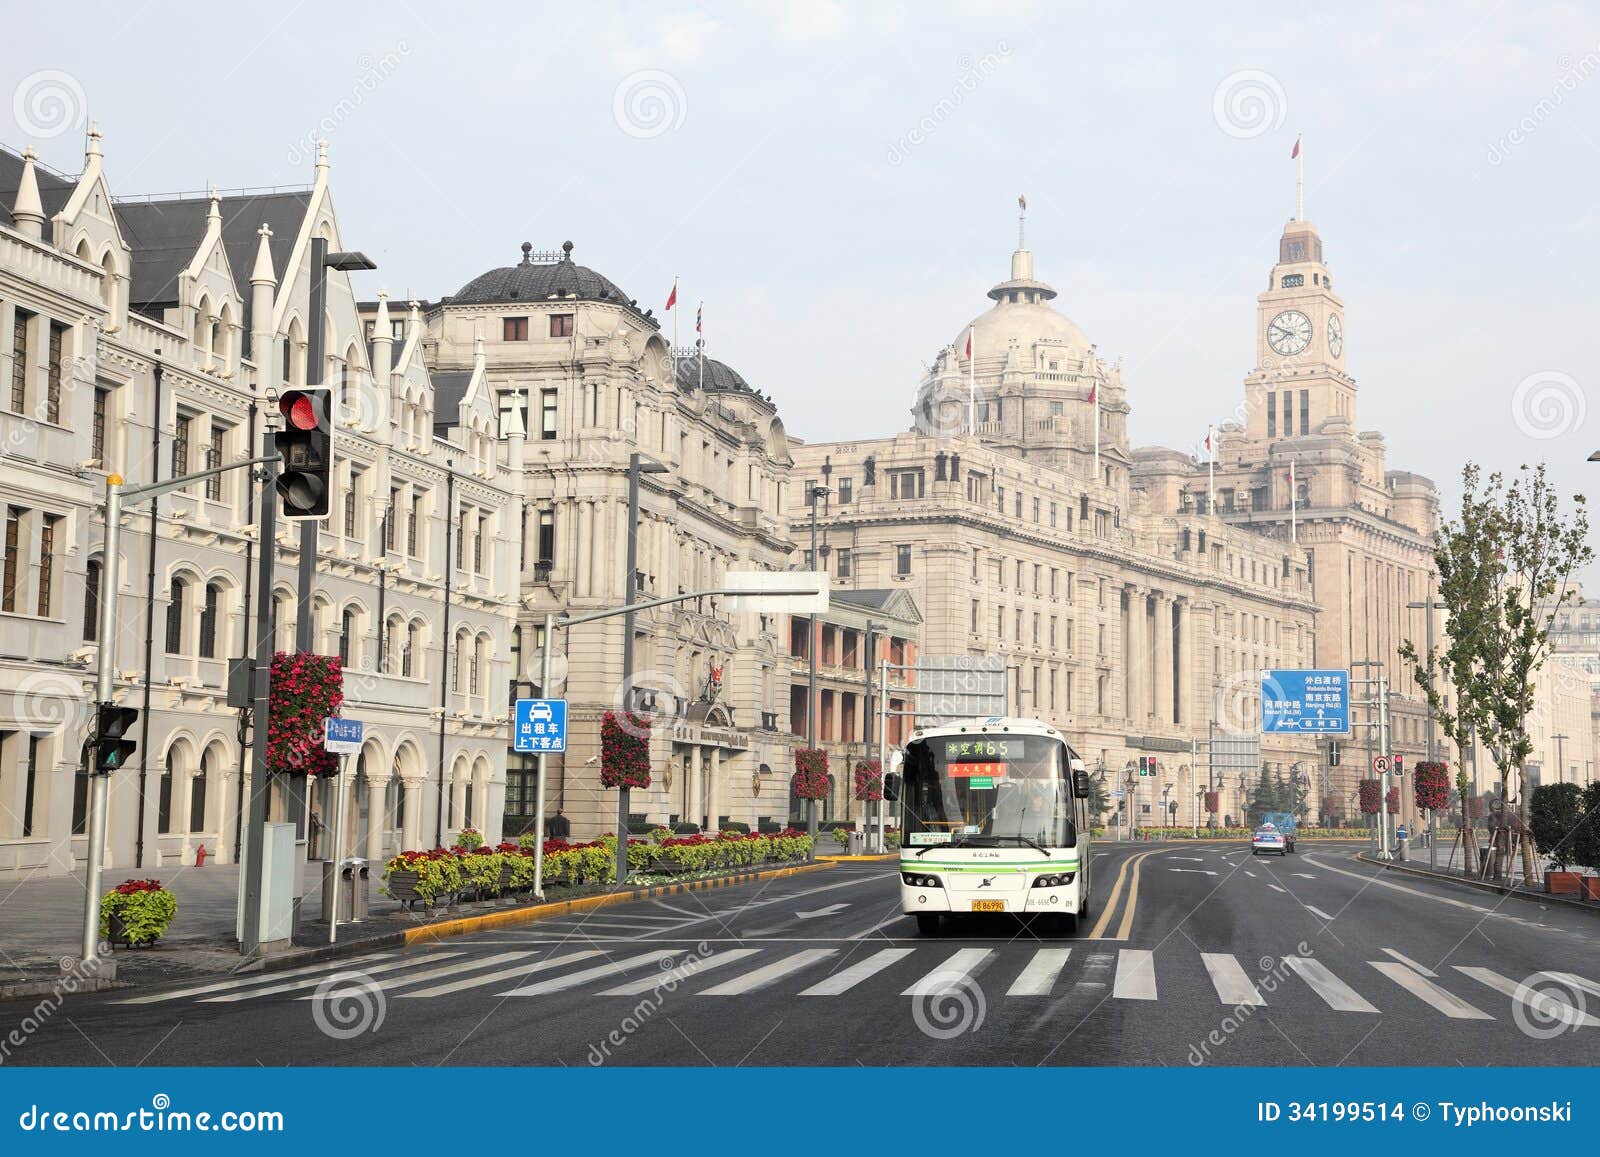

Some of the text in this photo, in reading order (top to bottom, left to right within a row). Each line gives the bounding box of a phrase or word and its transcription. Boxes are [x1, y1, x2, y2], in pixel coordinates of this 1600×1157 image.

[1304, 675, 1341, 685] 外白渡桥
[1305, 693, 1341, 702] 南京东路
[1264, 700, 1301, 709] 河南中路
[521, 722, 559, 734] 出租车
[516, 736, 563, 749] 上下客点
